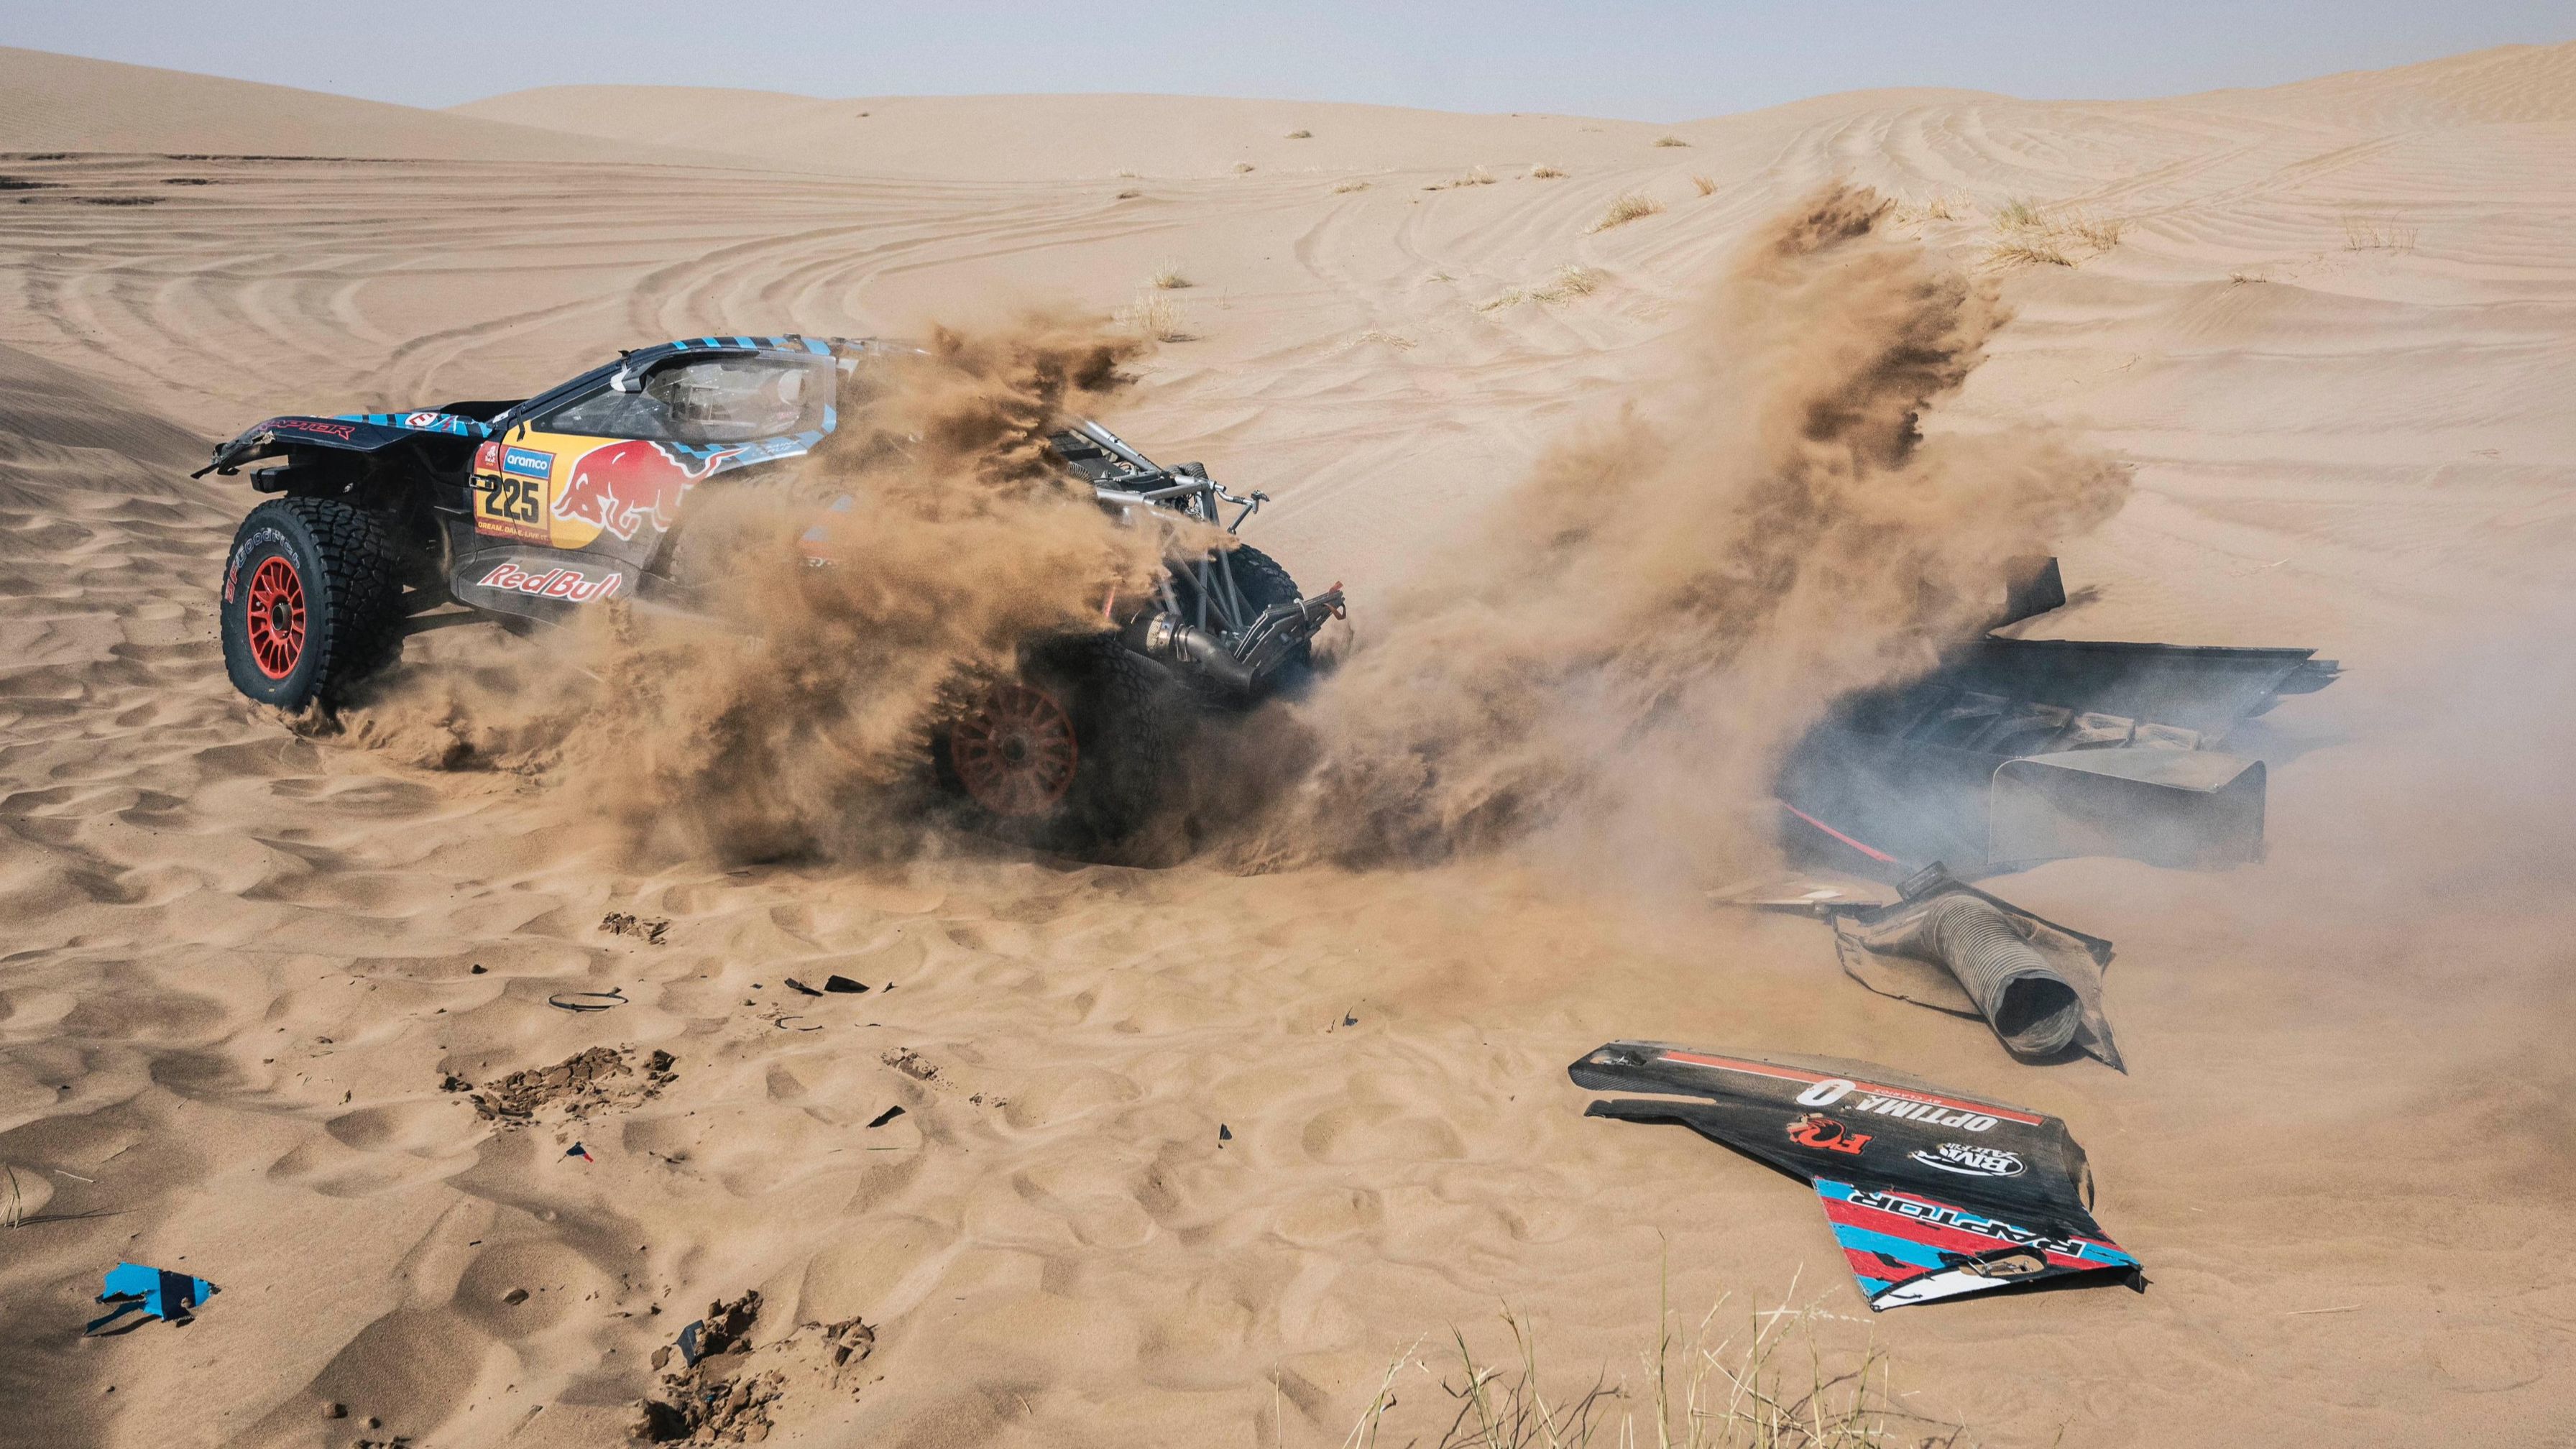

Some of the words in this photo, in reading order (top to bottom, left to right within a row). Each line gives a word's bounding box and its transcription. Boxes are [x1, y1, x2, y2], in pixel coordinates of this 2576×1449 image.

[507, 454, 548, 470] aramco
[485, 474, 539, 524] 225
[478, 521, 504, 531] DREAM.
[505, 526, 524, 537] DARE.
[1874, 1088, 1923, 1101] CLARIOS
[1854, 1095, 2000, 1133] OPTIMA
[1846, 1190, 2087, 1258] RAPTOR
